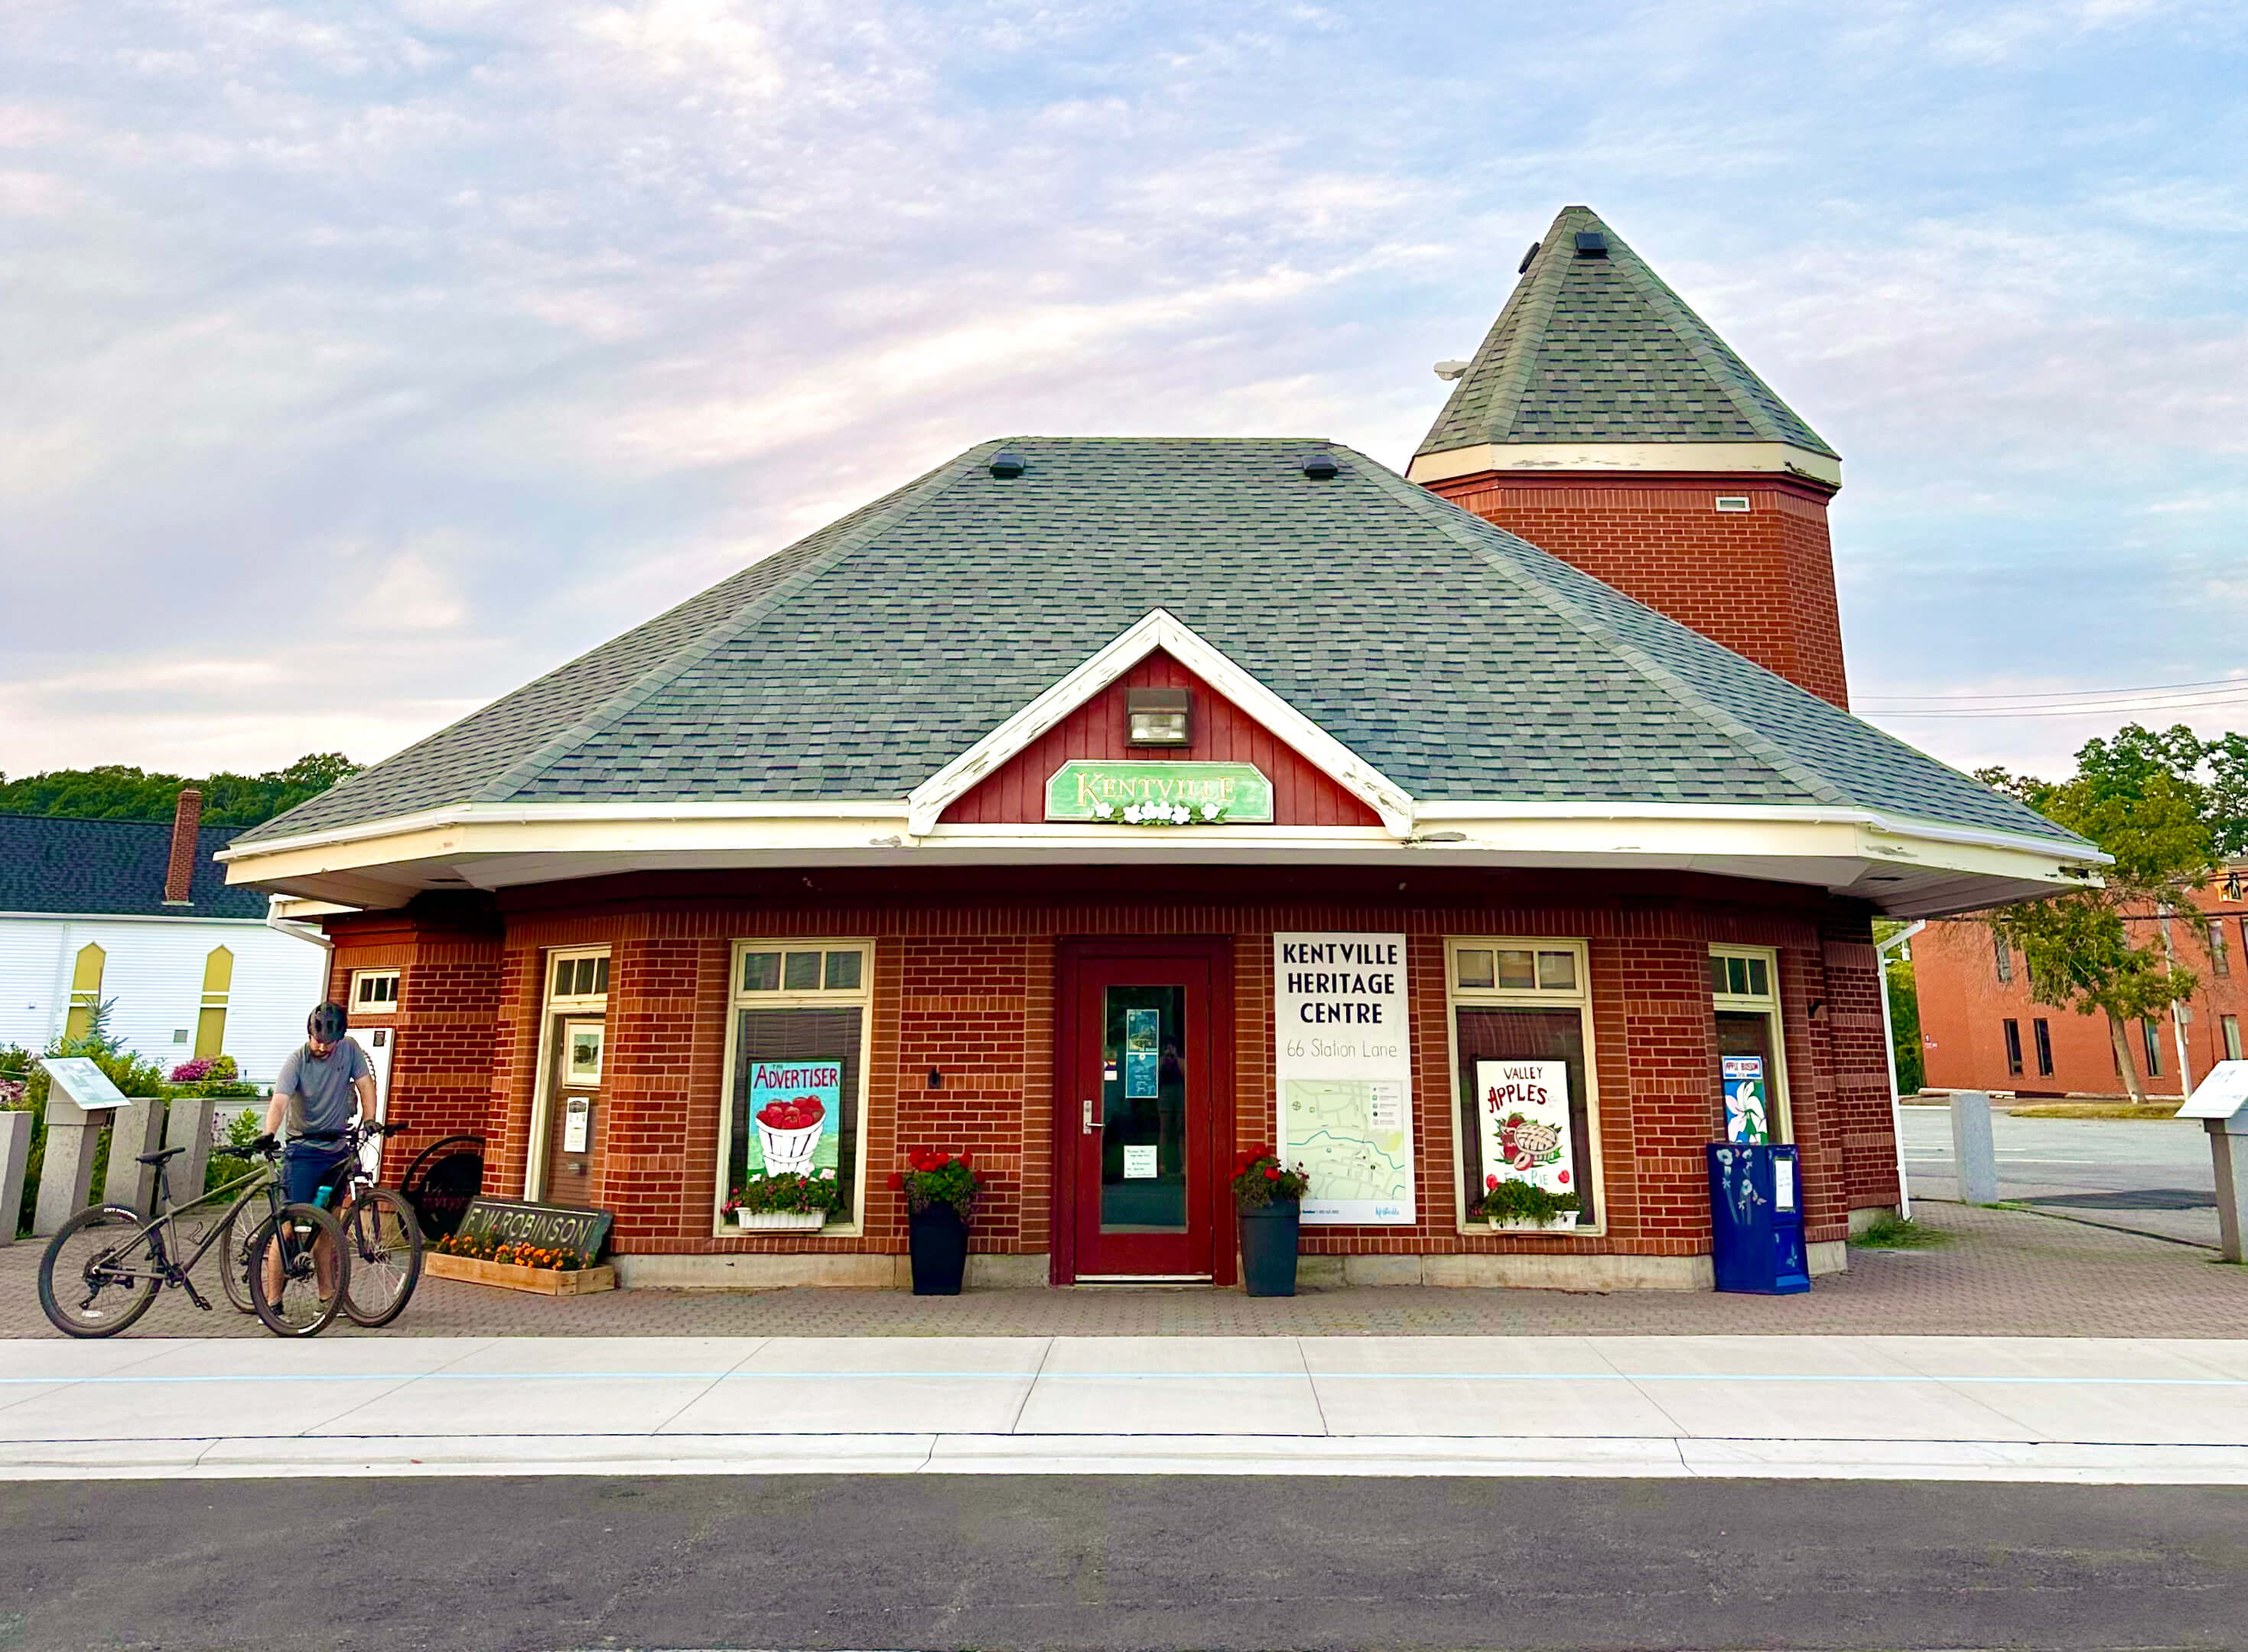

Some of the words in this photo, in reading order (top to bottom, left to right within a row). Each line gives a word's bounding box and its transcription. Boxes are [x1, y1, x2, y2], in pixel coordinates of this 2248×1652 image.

[1074, 772, 1237, 806] KENTVILLE
[1283, 944, 1397, 964] KENTVILLE
[1288, 973, 1395, 994] HERITAGE
[1300, 1003, 1382, 1024] CENTRE
[1287, 1039, 1305, 1057] 66
[1311, 1038, 1356, 1057] Station
[1362, 1040, 1397, 1058] Lane
[753, 1065, 838, 1089] ADVERTISER
[1503, 1067, 1543, 1080] VALLEY
[1488, 1083, 1547, 1114] APPLES
[1531, 1169, 1549, 1187] PIE
[496, 1211, 593, 1246] ROBINSON
